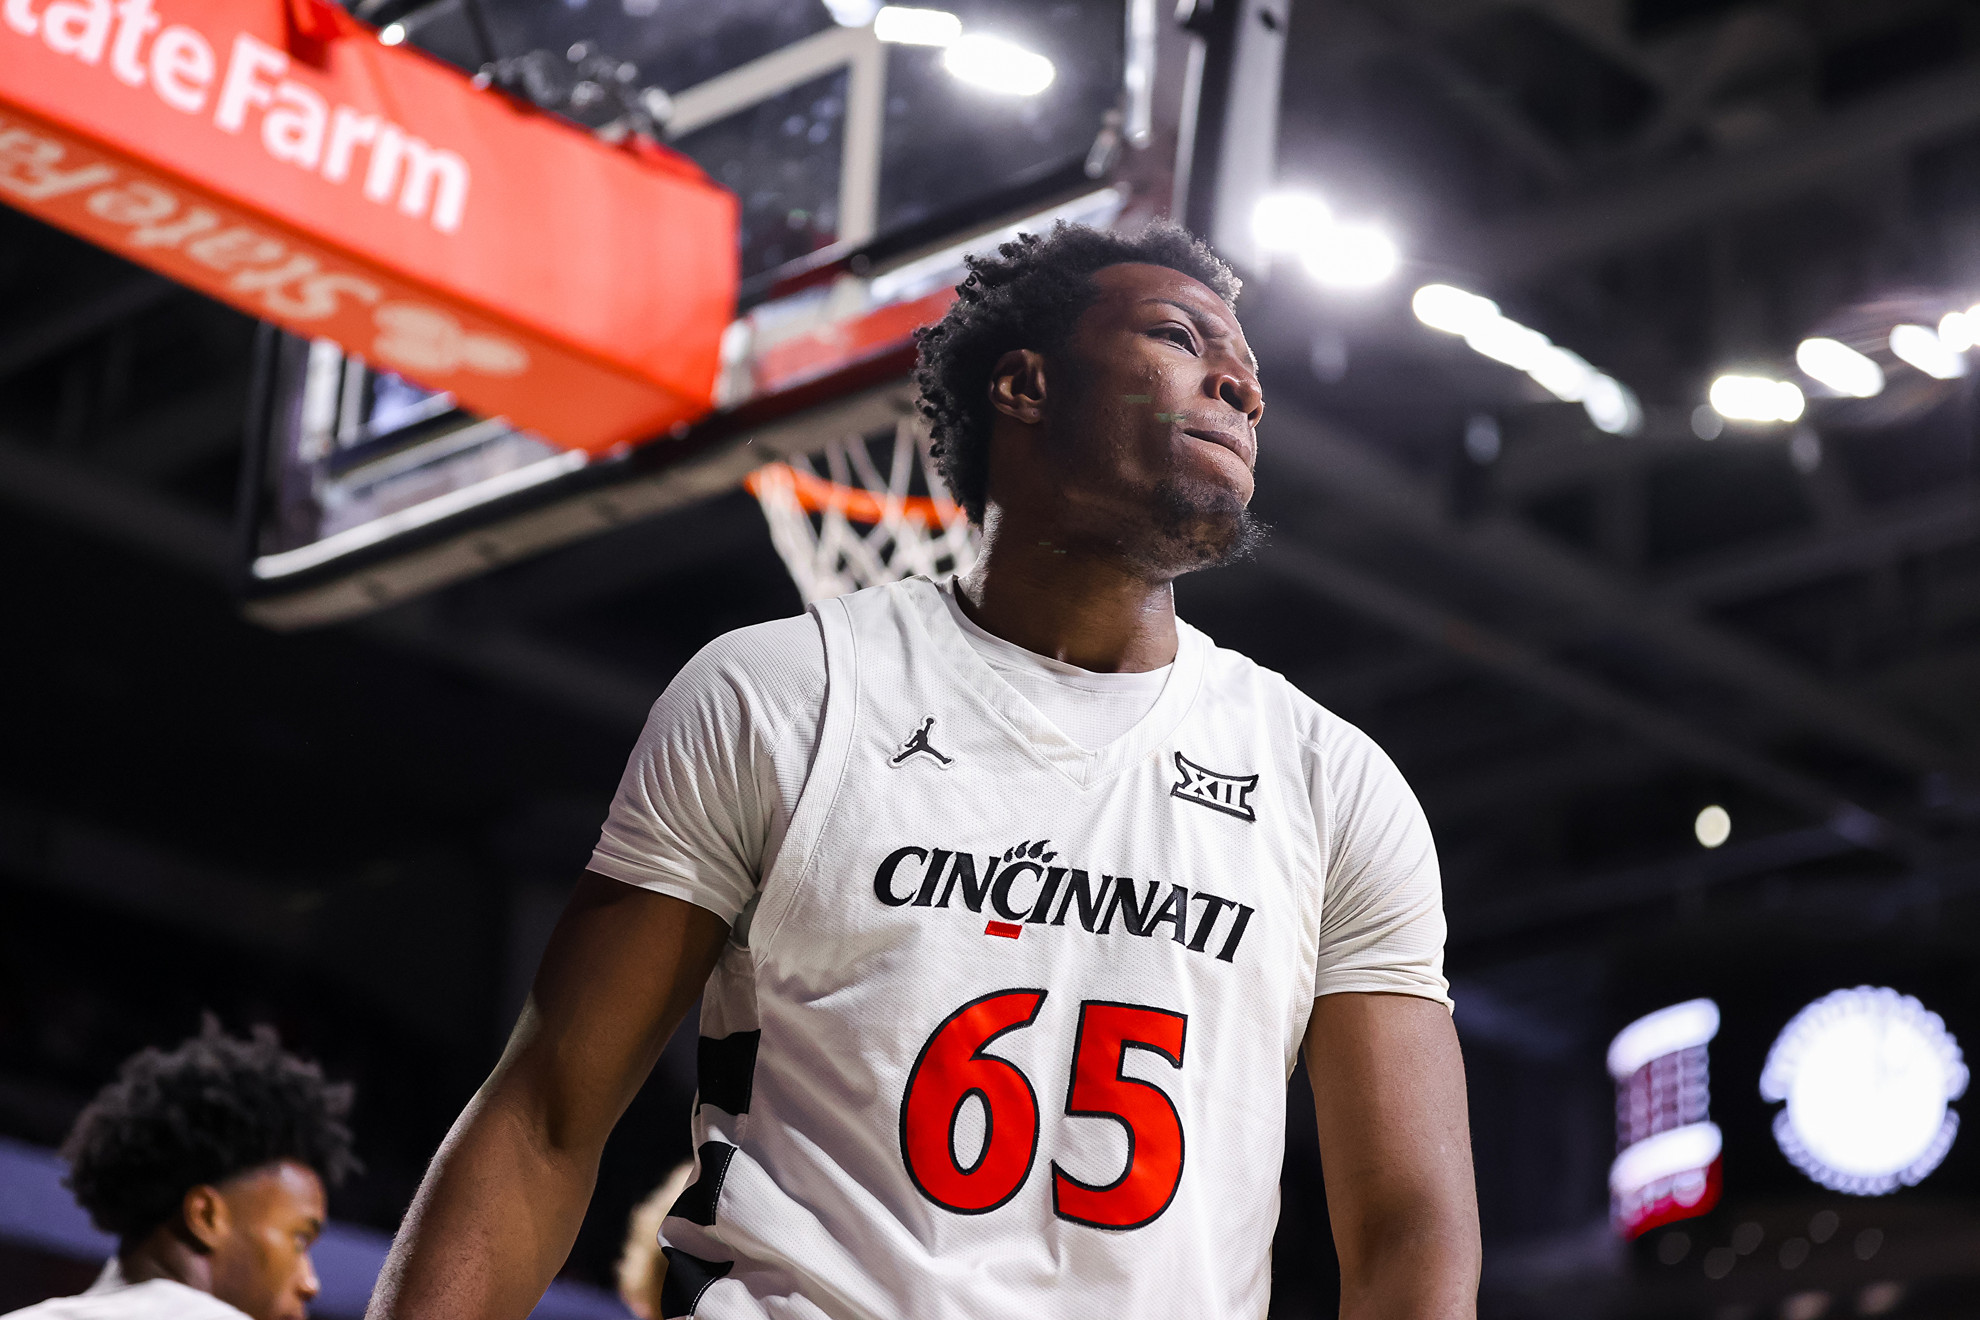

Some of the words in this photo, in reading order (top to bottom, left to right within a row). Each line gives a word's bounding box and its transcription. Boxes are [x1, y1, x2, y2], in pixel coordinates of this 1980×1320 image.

[1171, 752, 1258, 822] XII
[874, 843, 1255, 963] CINCINNATI
[899, 988, 1188, 1231] 65
